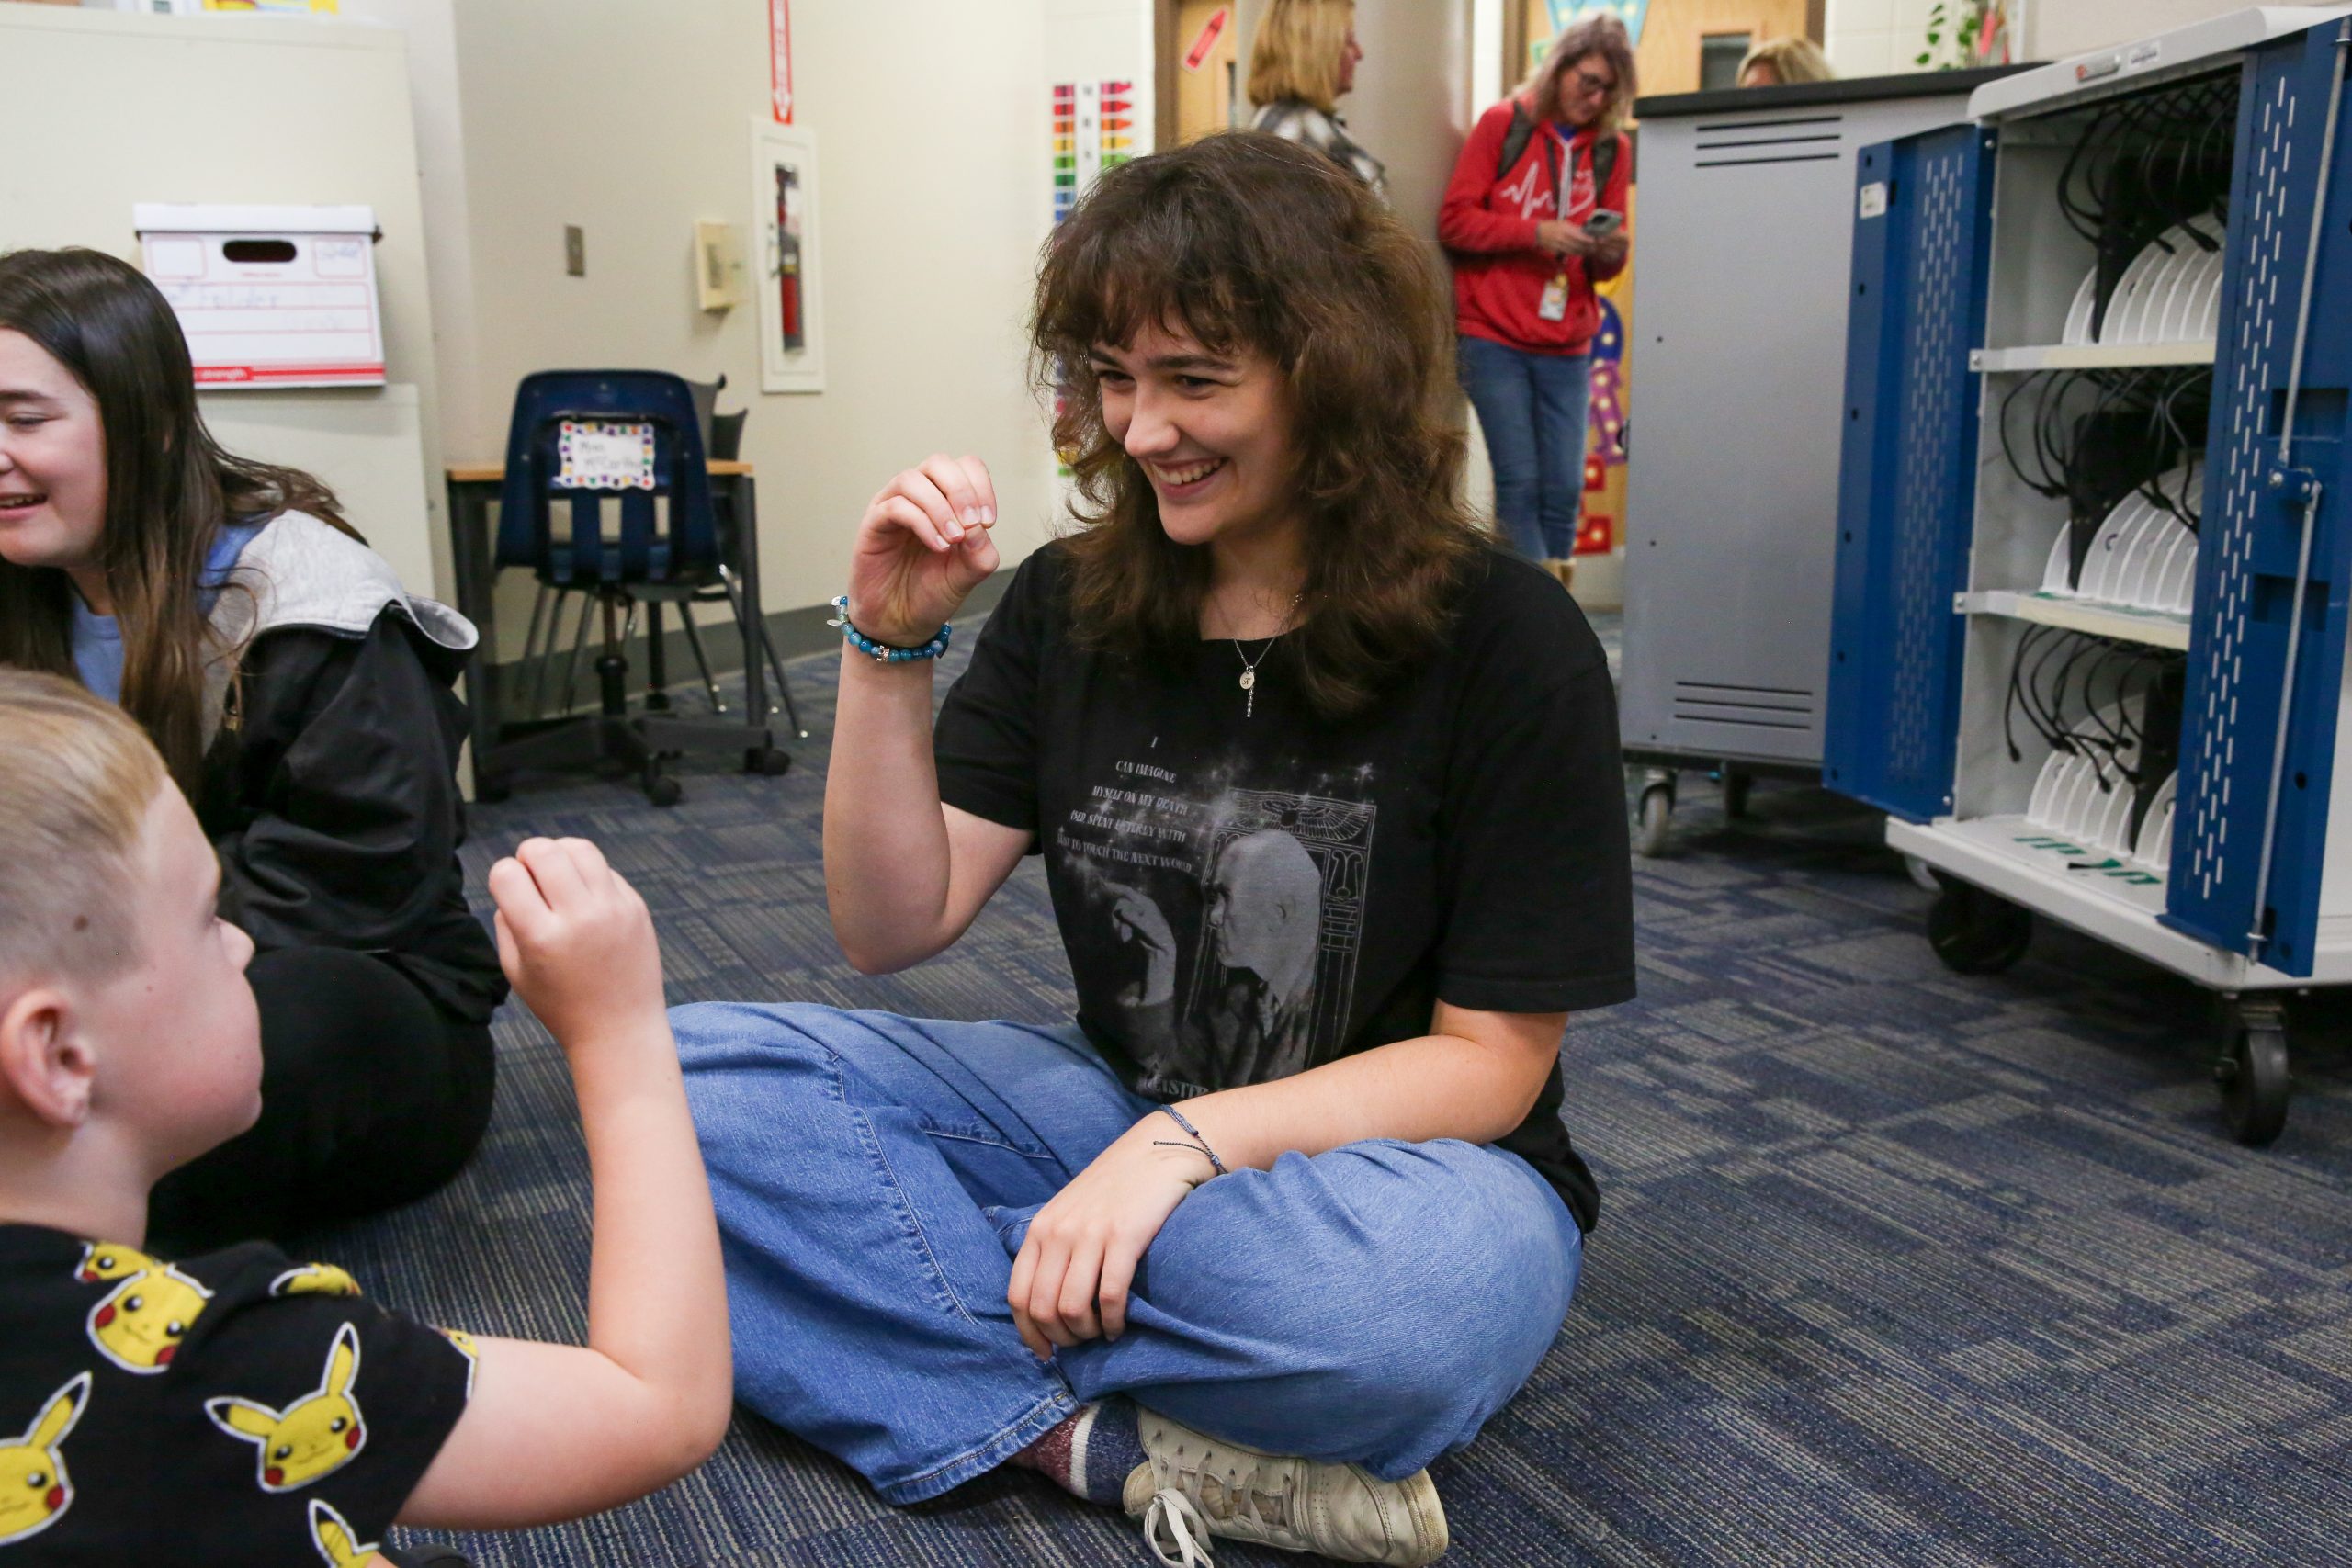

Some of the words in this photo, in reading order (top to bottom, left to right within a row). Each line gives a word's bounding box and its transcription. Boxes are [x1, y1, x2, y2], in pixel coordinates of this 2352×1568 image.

[1150, 736, 1159, 749] I
[1115, 761, 1135, 773] CAN
[1136, 762, 1177, 784] IMAGINE
[1091, 785, 1124, 802] MYSELF
[1124, 791, 1138, 805] ON
[1138, 793, 1156, 807] MY
[1156, 796, 1189, 816] DEATH
[1087, 813, 1114, 829] SPENT
[1158, 826, 1187, 843] WITH
[1071, 838, 1082, 852] TO
[1082, 840, 1111, 859] TOUCH
[1111, 848, 1130, 862] THE
[1130, 851, 1160, 866] NEXT
[1160, 856, 1193, 874] WORLD
